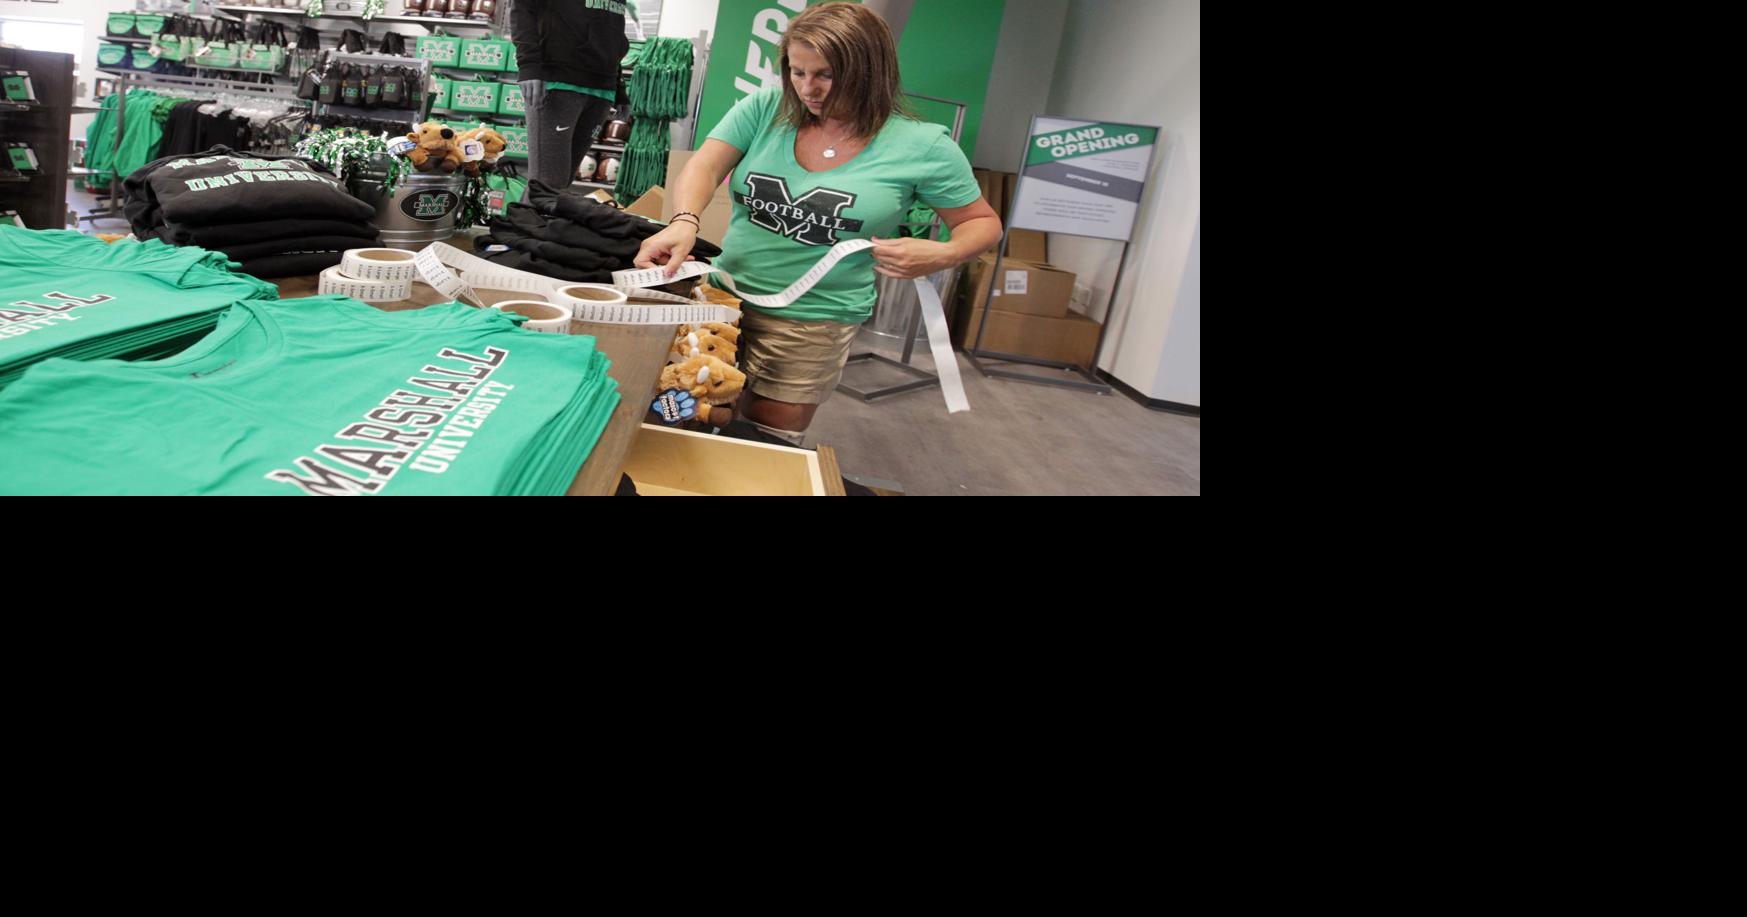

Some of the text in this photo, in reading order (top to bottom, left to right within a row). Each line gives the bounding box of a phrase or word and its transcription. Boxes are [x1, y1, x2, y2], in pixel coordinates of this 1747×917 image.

[1036, 127, 1105, 148] GRAND
[1051, 133, 1140, 158] OPENING
[743, 195, 846, 231] FOOTBALL
[264, 346, 510, 495] MARSHALL
[409, 380, 515, 474] UNIVERSITY
